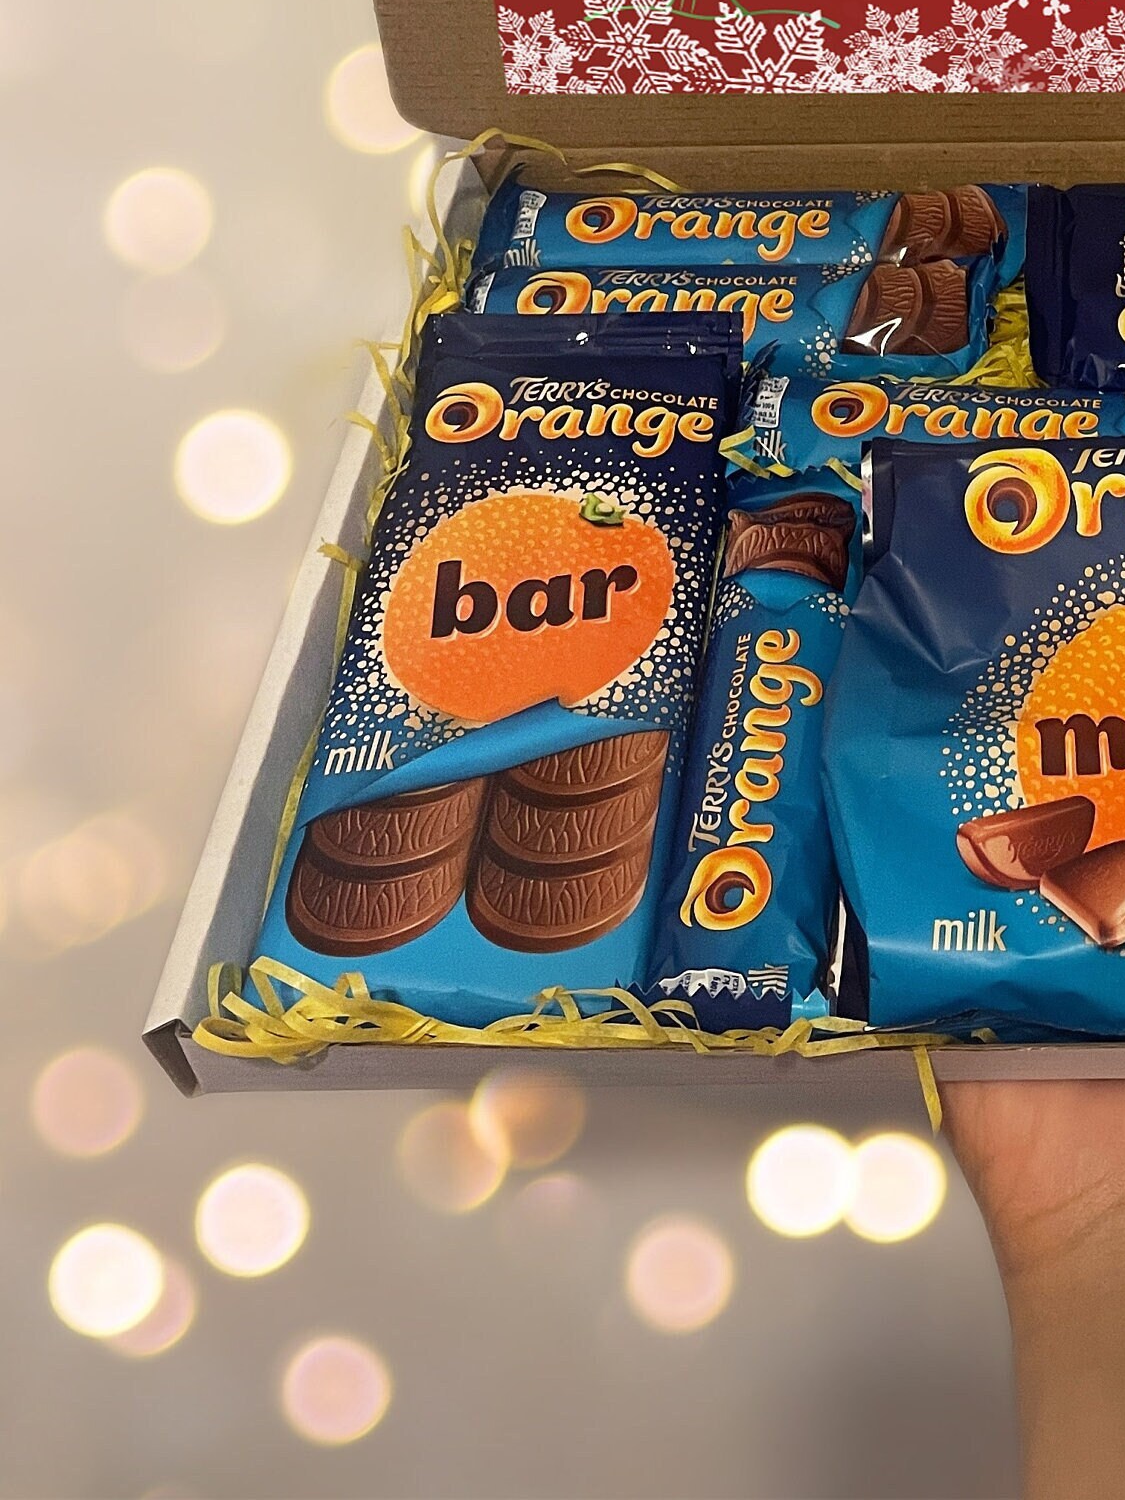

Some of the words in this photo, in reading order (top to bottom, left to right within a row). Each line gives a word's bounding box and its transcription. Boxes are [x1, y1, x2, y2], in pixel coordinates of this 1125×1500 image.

[735, 198, 834, 209] CHOCOLATE
[565, 196, 832, 262] Orange
[504, 239, 541, 269] milk
[597, 269, 694, 287] TERRY'S
[695, 275, 799, 287] CHOCOLATE
[508, 376, 611, 405] TERRY'S
[610, 388, 719, 411] CHOCOLATE
[995, 395, 1102, 409] CHOCOLATE
[425, 382, 714, 458] Orange
[430, 560, 639, 639] bar
[323, 730, 398, 776] milk
[688, 741, 735, 852] TERRY'S
[722, 632, 752, 740] CHOCOLATE
[679, 628, 824, 931] Orange
[932, 910, 1007, 952] milk
